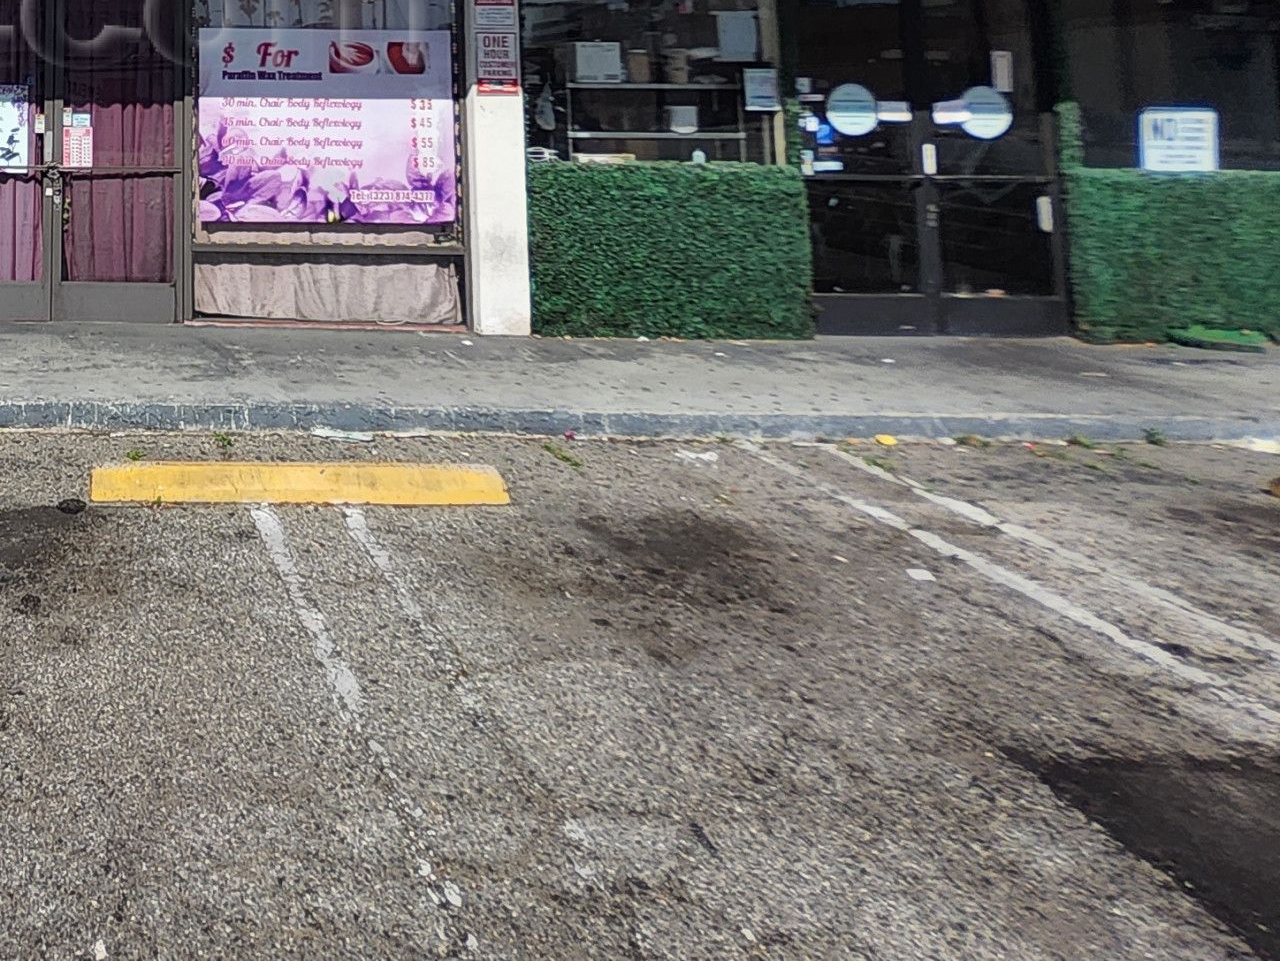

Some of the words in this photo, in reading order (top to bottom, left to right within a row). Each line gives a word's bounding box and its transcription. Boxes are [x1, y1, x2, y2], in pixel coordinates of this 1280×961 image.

[483, 36, 509, 48] ONE
[222, 42, 235, 68] $
[256, 42, 299, 68] For
[483, 49, 509, 59] HOUR
[222, 70, 256, 80] Paraffin
[257, 70, 276, 80] Wax
[278, 71, 322, 80] Treatment
[222, 97, 235, 107] 30
[259, 97, 284, 107] Chair
[286, 97, 310, 110] Body
[313, 97, 362, 110] Reflexology
[259, 117, 284, 127] Chair
[286, 118, 310, 129] Body
[313, 118, 362, 130] Reflexology
[260, 136, 284, 146] Chair
[286, 137, 310, 149] Body
[313, 137, 363, 149] Reflexology
[287, 157, 311, 169] Body
[313, 157, 363, 169] Reflexology
